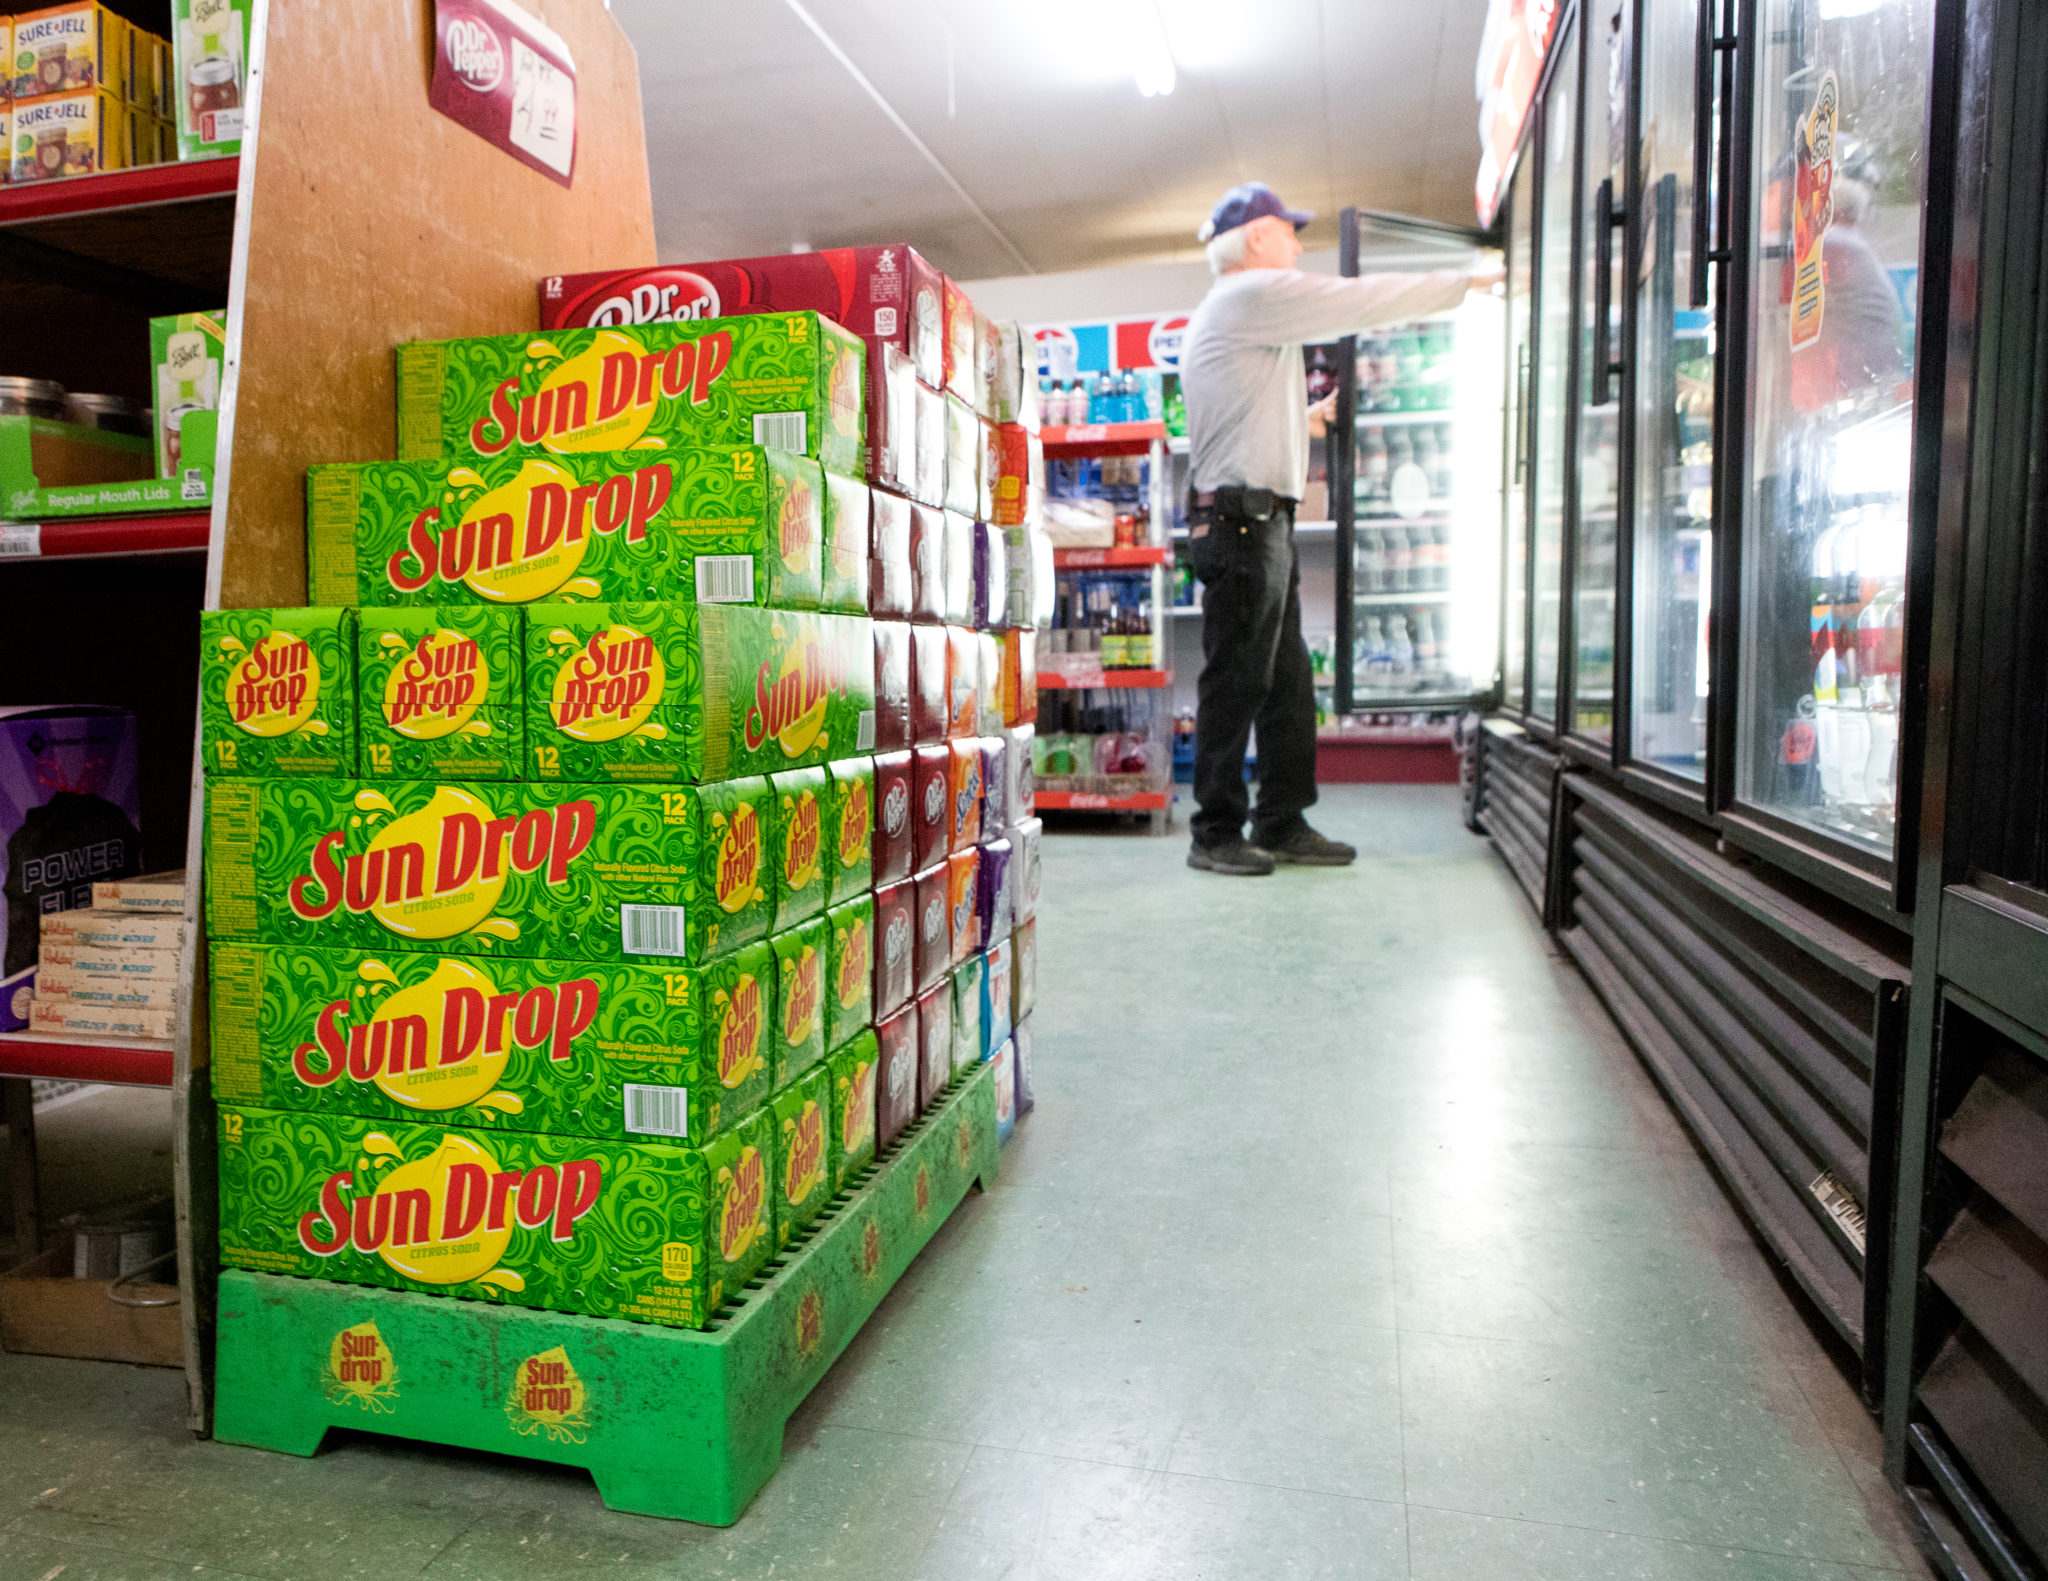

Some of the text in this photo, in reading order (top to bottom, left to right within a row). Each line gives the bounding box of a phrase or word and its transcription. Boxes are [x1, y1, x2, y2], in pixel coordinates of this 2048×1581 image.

[466, 21, 488, 50] Dr
[546, 277, 563, 292] 12
[631, 283, 679, 325] Dr
[786, 317, 808, 336] 12
[878, 311, 894, 322] 150
[470, 377, 588, 457] Sun
[593, 331, 732, 426] Drop
[569, 417, 631, 443] CITRUS SODA
[731, 452, 755, 472] 12
[734, 473, 754, 481] PACK
[48, 492, 95, 509] Regular
[99, 489, 141, 504] Mouth
[144, 487, 170, 500] Lids
[386, 507, 514, 593] Sun
[520, 463, 673, 563] Drop
[670, 517, 755, 529] Naturally Flavored Citrus Soda
[706, 527, 726, 535] Natural
[493, 555, 560, 581] CITRUS SODA
[242, 637, 309, 685] Sun
[404, 634, 478, 683] Sun
[572, 631, 654, 681] Sun
[233, 673, 307, 726] Drop
[388, 672, 475, 728] Drop
[556, 670, 650, 729] Drop
[745, 660, 801, 752] Sun
[215, 741, 237, 761] 12
[368, 744, 392, 765] 12
[535, 747, 560, 768] 12
[661, 793, 687, 815] 12
[664, 816, 687, 824] PACK
[793, 795, 818, 838] Sun
[725, 809, 757, 859] Sun
[288, 830, 424, 921] Sun
[431, 799, 597, 898] Drop
[787, 826, 817, 883] Drop
[23, 840, 124, 893] POWER
[594, 861, 687, 874] Naturally Flavored Citrus Soda
[718, 842, 756, 905] Drop
[616, 874, 631, 882] other
[633, 874, 655, 882] Natural
[656, 875, 679, 883] Flavors
[161, 899, 185, 907] BOXE
[403, 892, 474, 915] CITRUS SODA
[708, 924, 719, 945] 12
[663, 975, 689, 997] 12
[666, 998, 688, 1006] PACK
[727, 979, 758, 1034] Sun
[292, 1000, 427, 1088] Sun
[436, 978, 599, 1069] Drop
[597, 1040, 689, 1054] Naturally Flavored Citrus Soda
[635, 1054, 657, 1062] Natural
[659, 1055, 682, 1063] Flavors
[720, 1011, 757, 1083] Drop
[406, 1065, 478, 1085] CITRUS SODA
[223, 1114, 243, 1135] 12
[729, 1150, 761, 1211] Sun
[297, 1159, 602, 1257] Sun Drop
[724, 1181, 760, 1258] Drop
[409, 1242, 480, 1259] CITRUS SODA
[666, 1247, 688, 1262] 170
[636, 1294, 655, 1305] CANS
[652, 1308, 671, 1318] CANS
[340, 1358, 382, 1386] drop
[525, 1387, 571, 1415] drop
